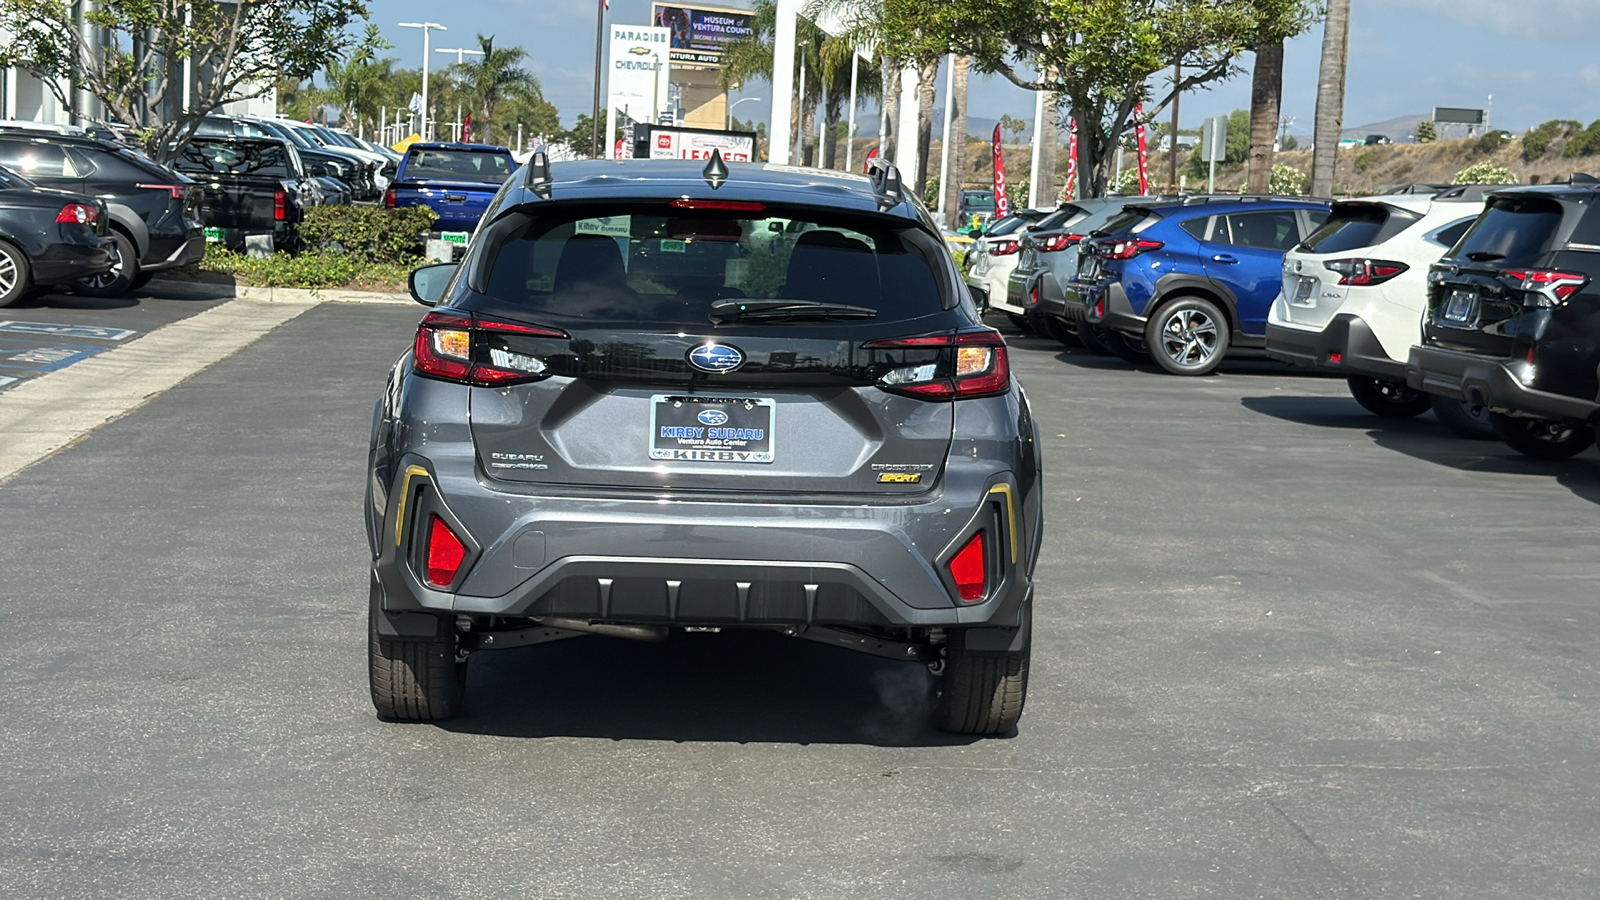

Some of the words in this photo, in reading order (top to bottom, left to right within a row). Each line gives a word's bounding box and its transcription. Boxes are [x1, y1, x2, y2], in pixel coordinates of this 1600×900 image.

[704, 16, 734, 25] MUSEUM
[692, 23, 725, 33] VENTURA
[615, 31, 666, 43] PARADISE
[698, 54, 719, 62] AUTO
[661, 426, 704, 438] KIRBY
[708, 428, 764, 440] SUBARU
[723, 439, 748, 447] Center
[491, 452, 544, 461] SUBARU
[673, 450, 750, 461] KIRBY
[871, 463, 934, 471] CROSSTREK
[880, 474, 918, 482] SPORT
